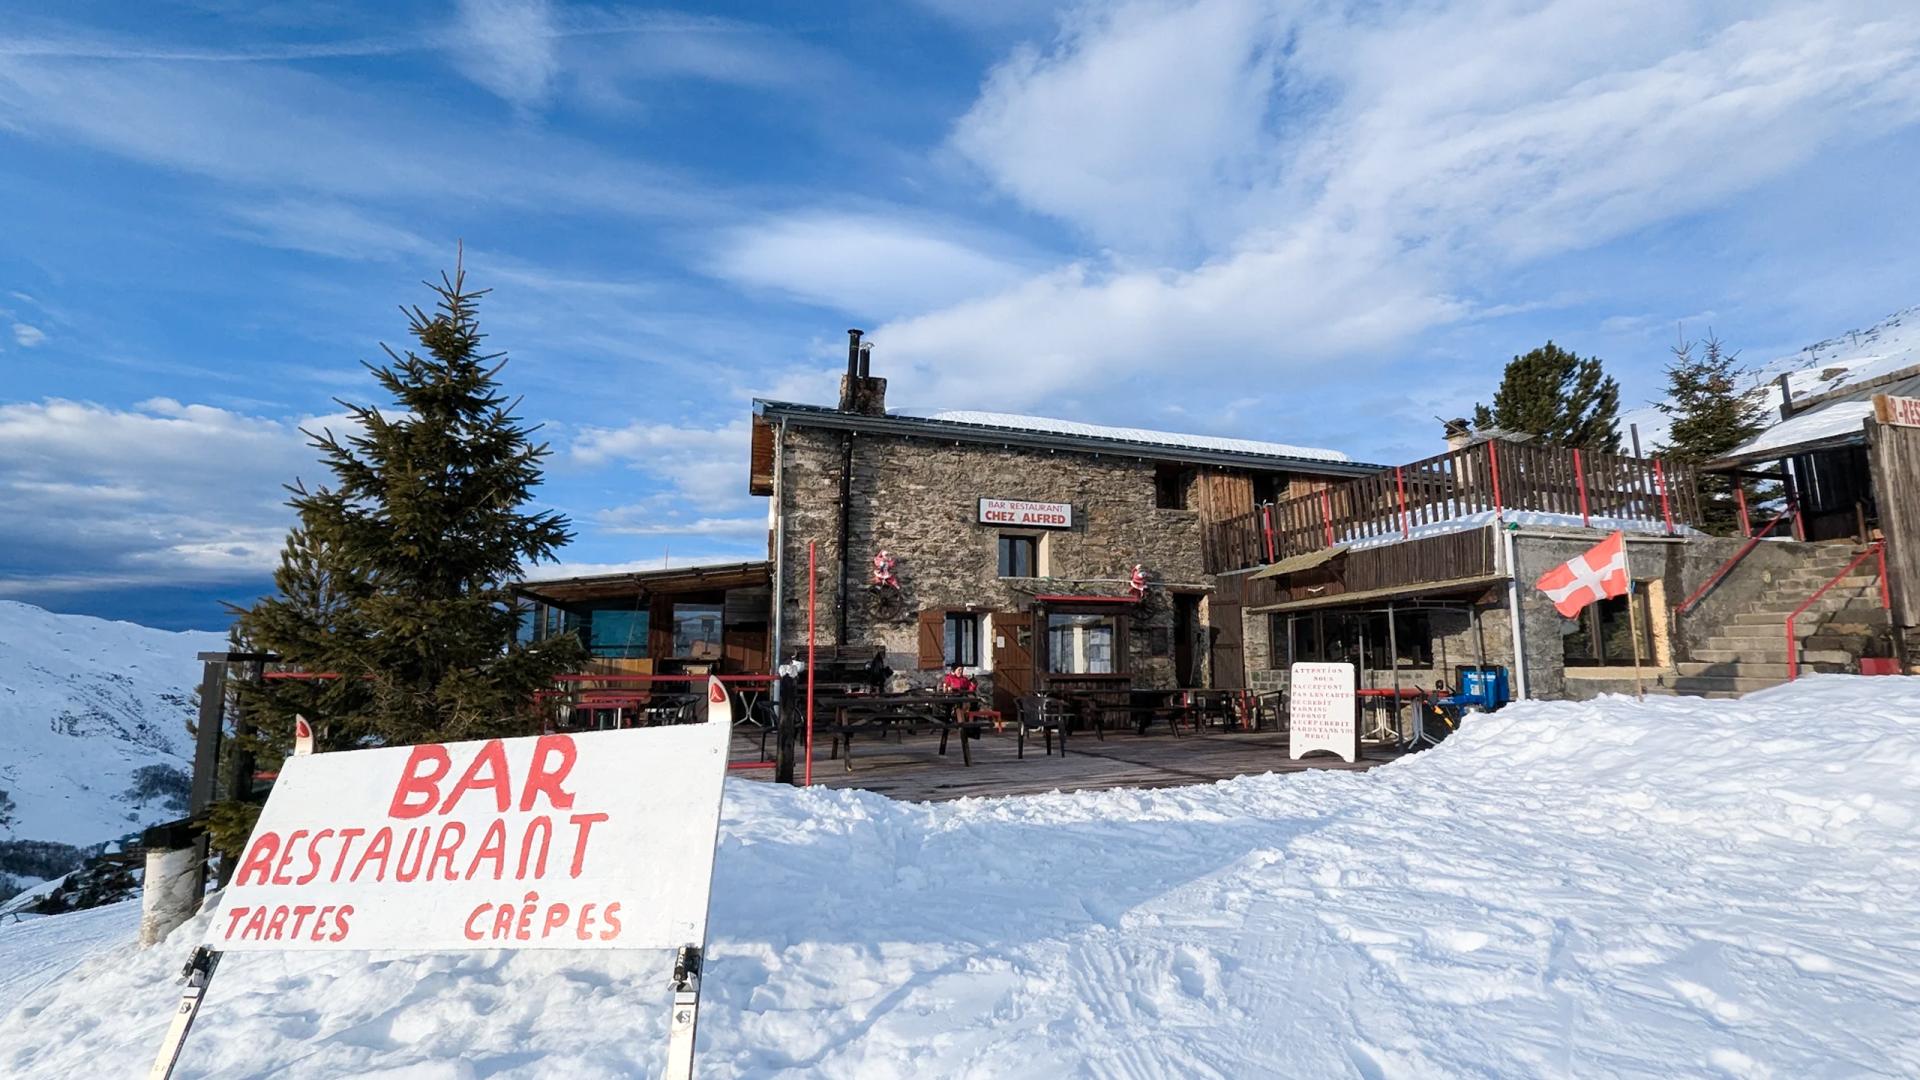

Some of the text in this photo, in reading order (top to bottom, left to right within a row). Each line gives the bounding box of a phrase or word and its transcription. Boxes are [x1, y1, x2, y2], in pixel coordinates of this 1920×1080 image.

[985, 511, 1066, 524] CHEZ ALFRED
[988, 500, 1064, 512] BAR RESTAURANT
[388, 735, 577, 819] BAR
[236, 813, 608, 886] RESTAURANT
[225, 892, 620, 942] TARTES CRÊPES
